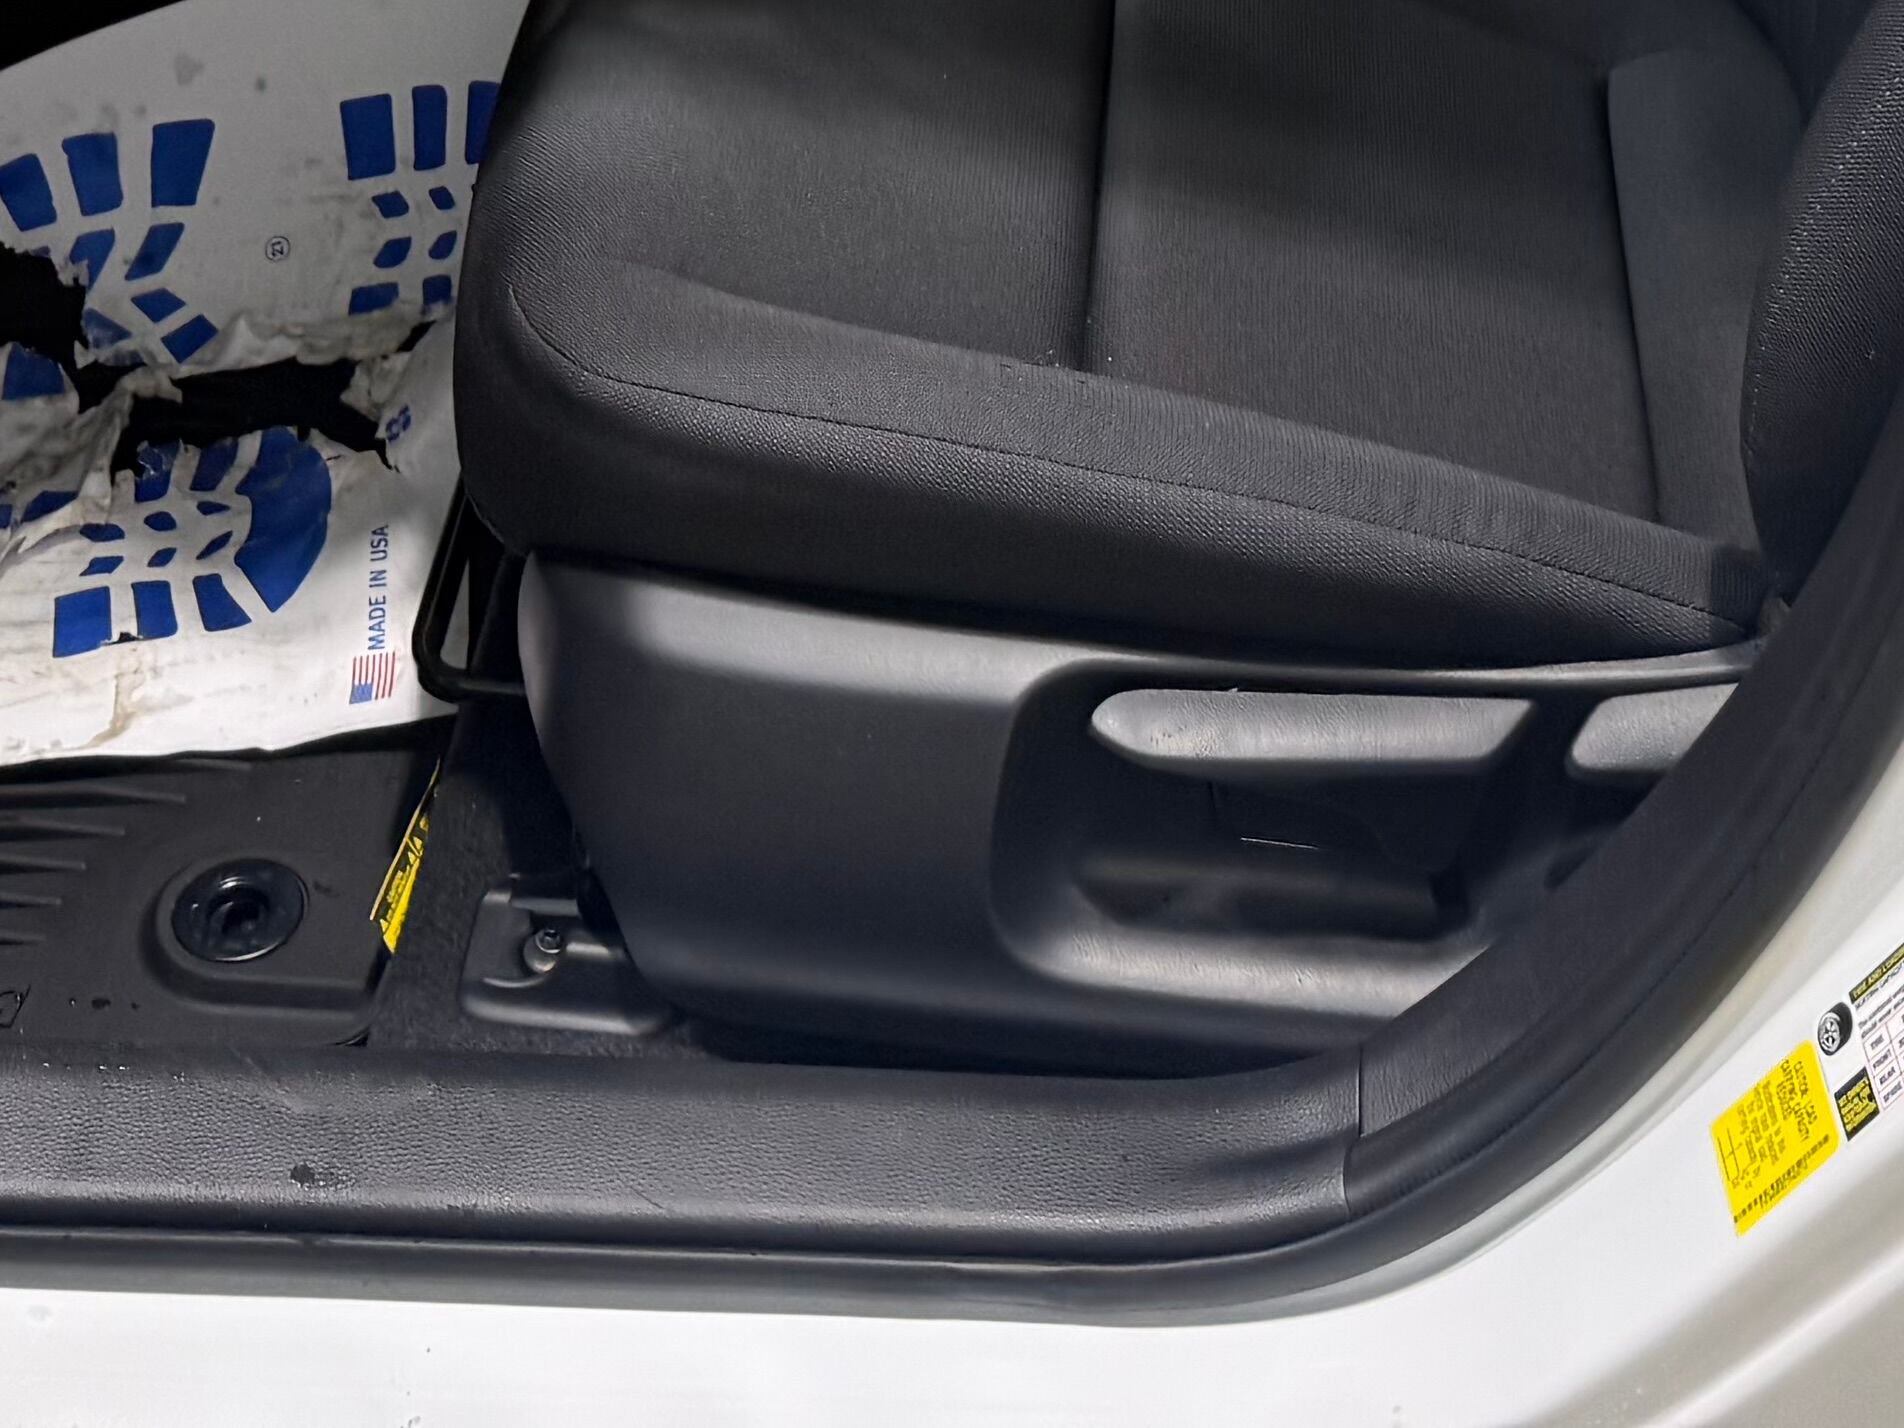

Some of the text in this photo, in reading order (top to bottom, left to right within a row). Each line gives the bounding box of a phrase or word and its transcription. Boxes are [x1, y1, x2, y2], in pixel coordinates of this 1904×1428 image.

[368, 525, 389, 650] MADE IN USA
